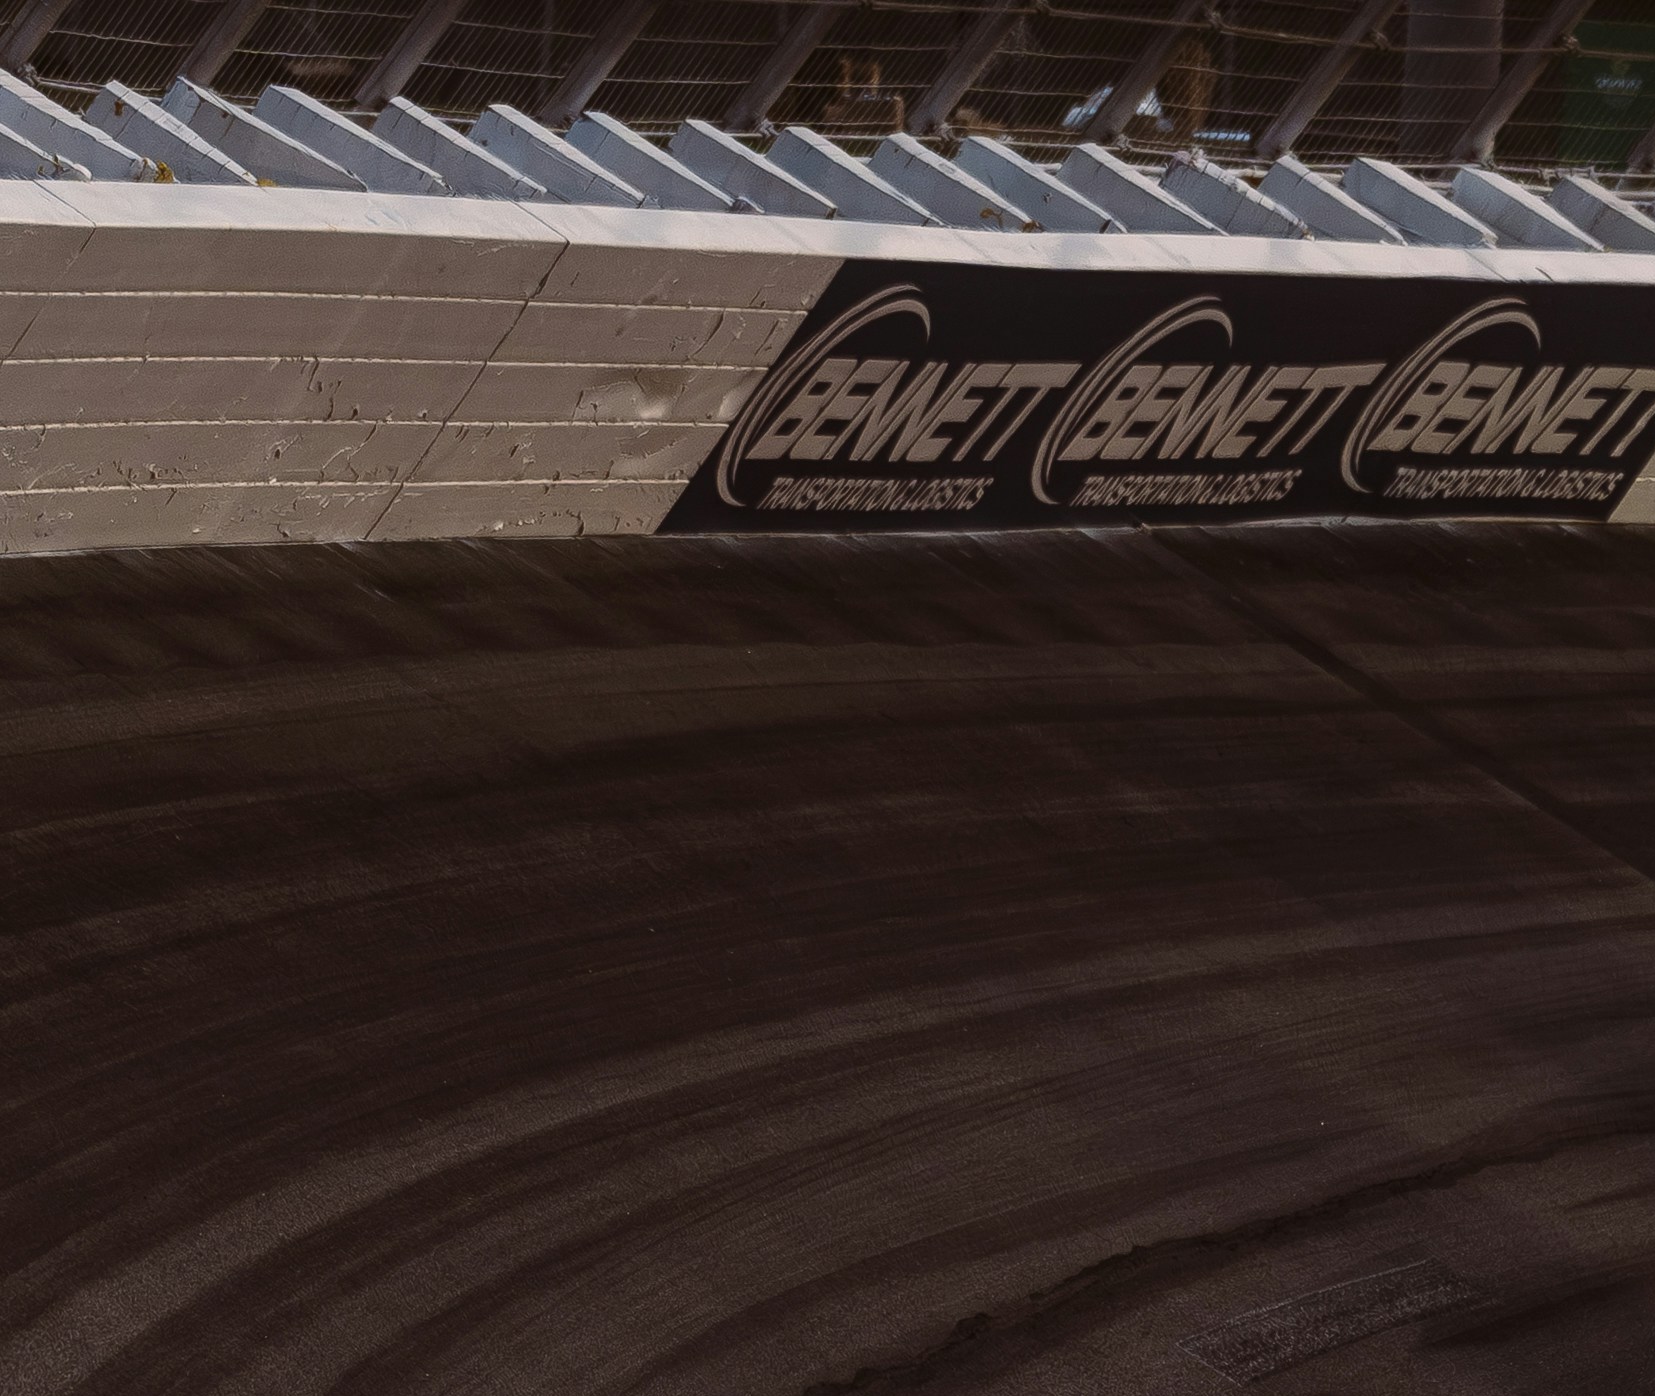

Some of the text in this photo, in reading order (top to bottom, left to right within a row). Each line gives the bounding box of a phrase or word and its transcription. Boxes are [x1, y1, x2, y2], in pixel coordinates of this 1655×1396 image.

[745, 358, 1082, 462] BENNETT
[1057, 363, 1387, 461] BENNETT
[756, 477, 900, 511] TRANSPORTATION
[1069, 472, 1211, 507] TRANSPORTATION
[1383, 467, 1528, 499] TRANSPORTATION
[1532, 468, 1624, 500] LOGISTICS
